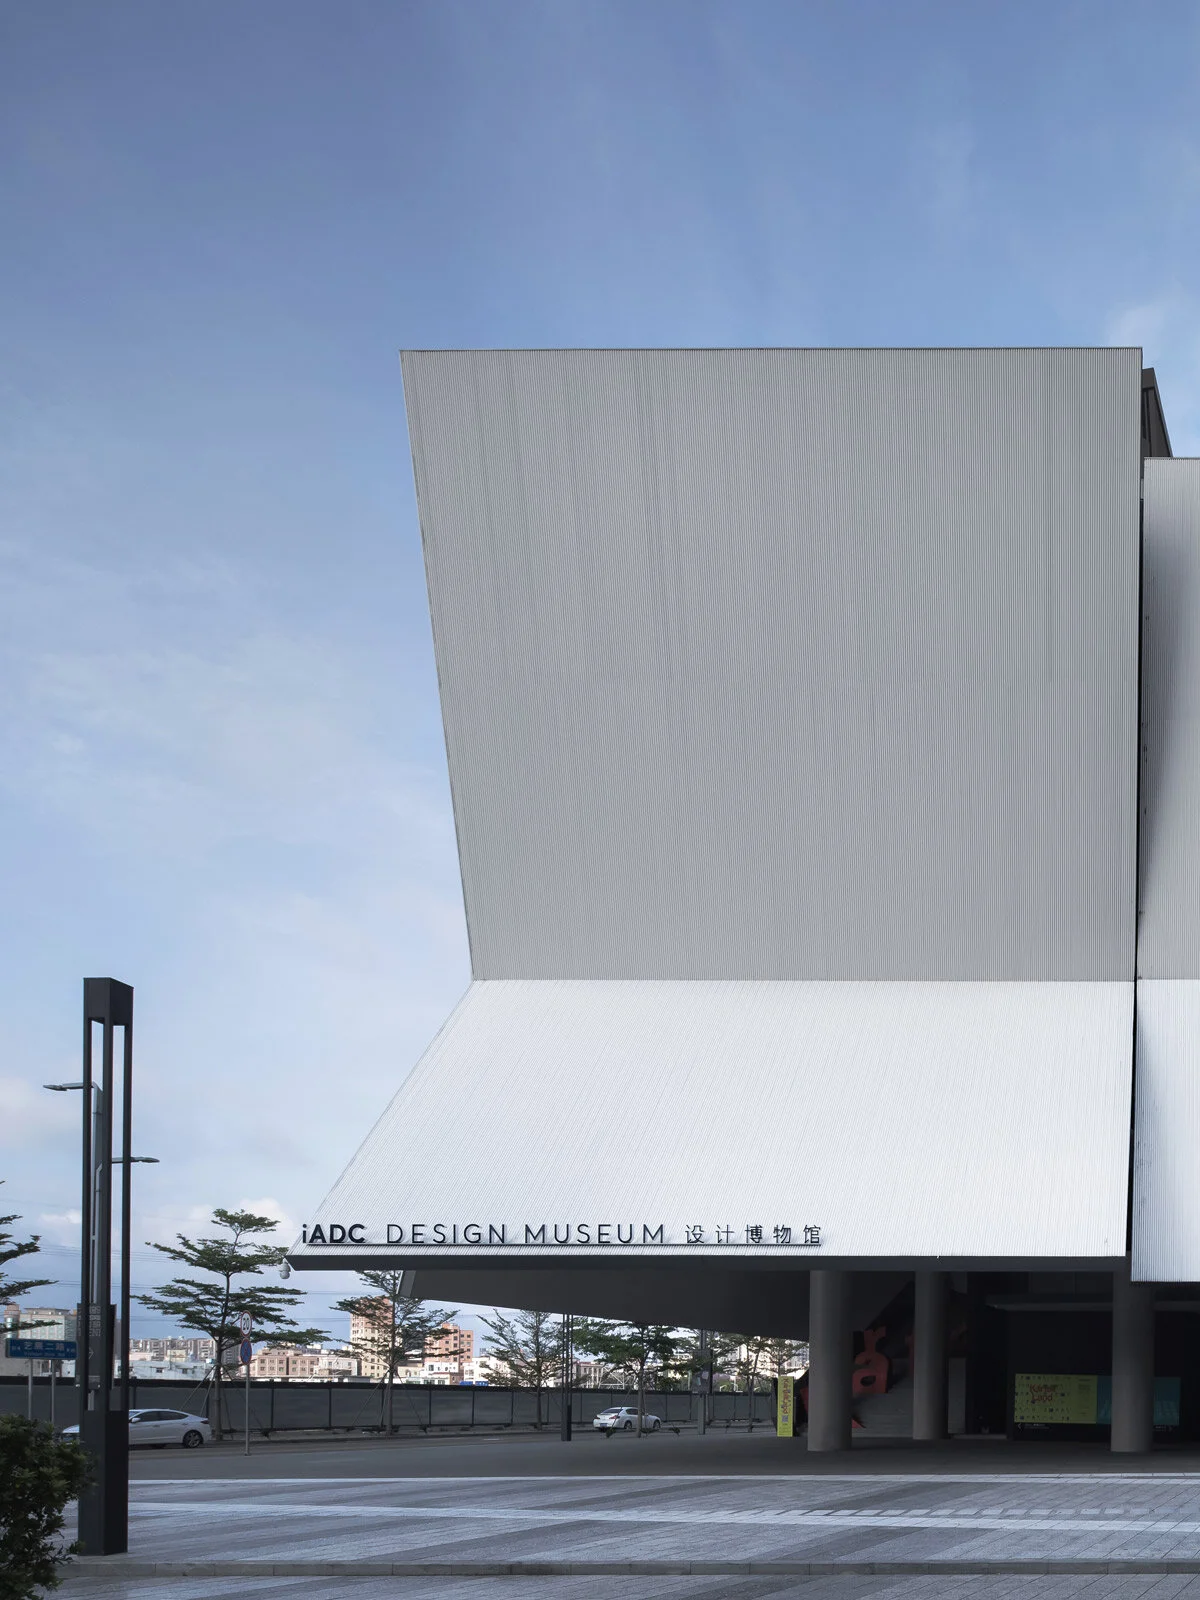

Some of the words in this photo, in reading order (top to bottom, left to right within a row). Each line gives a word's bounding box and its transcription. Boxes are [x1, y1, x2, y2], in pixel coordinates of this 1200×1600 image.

[302, 1223, 366, 1244] iADC
[387, 1223, 505, 1244] DESIGN
[524, 1223, 664, 1244] MUSEUM
[685, 1223, 821, 1244] 设计博物馆
